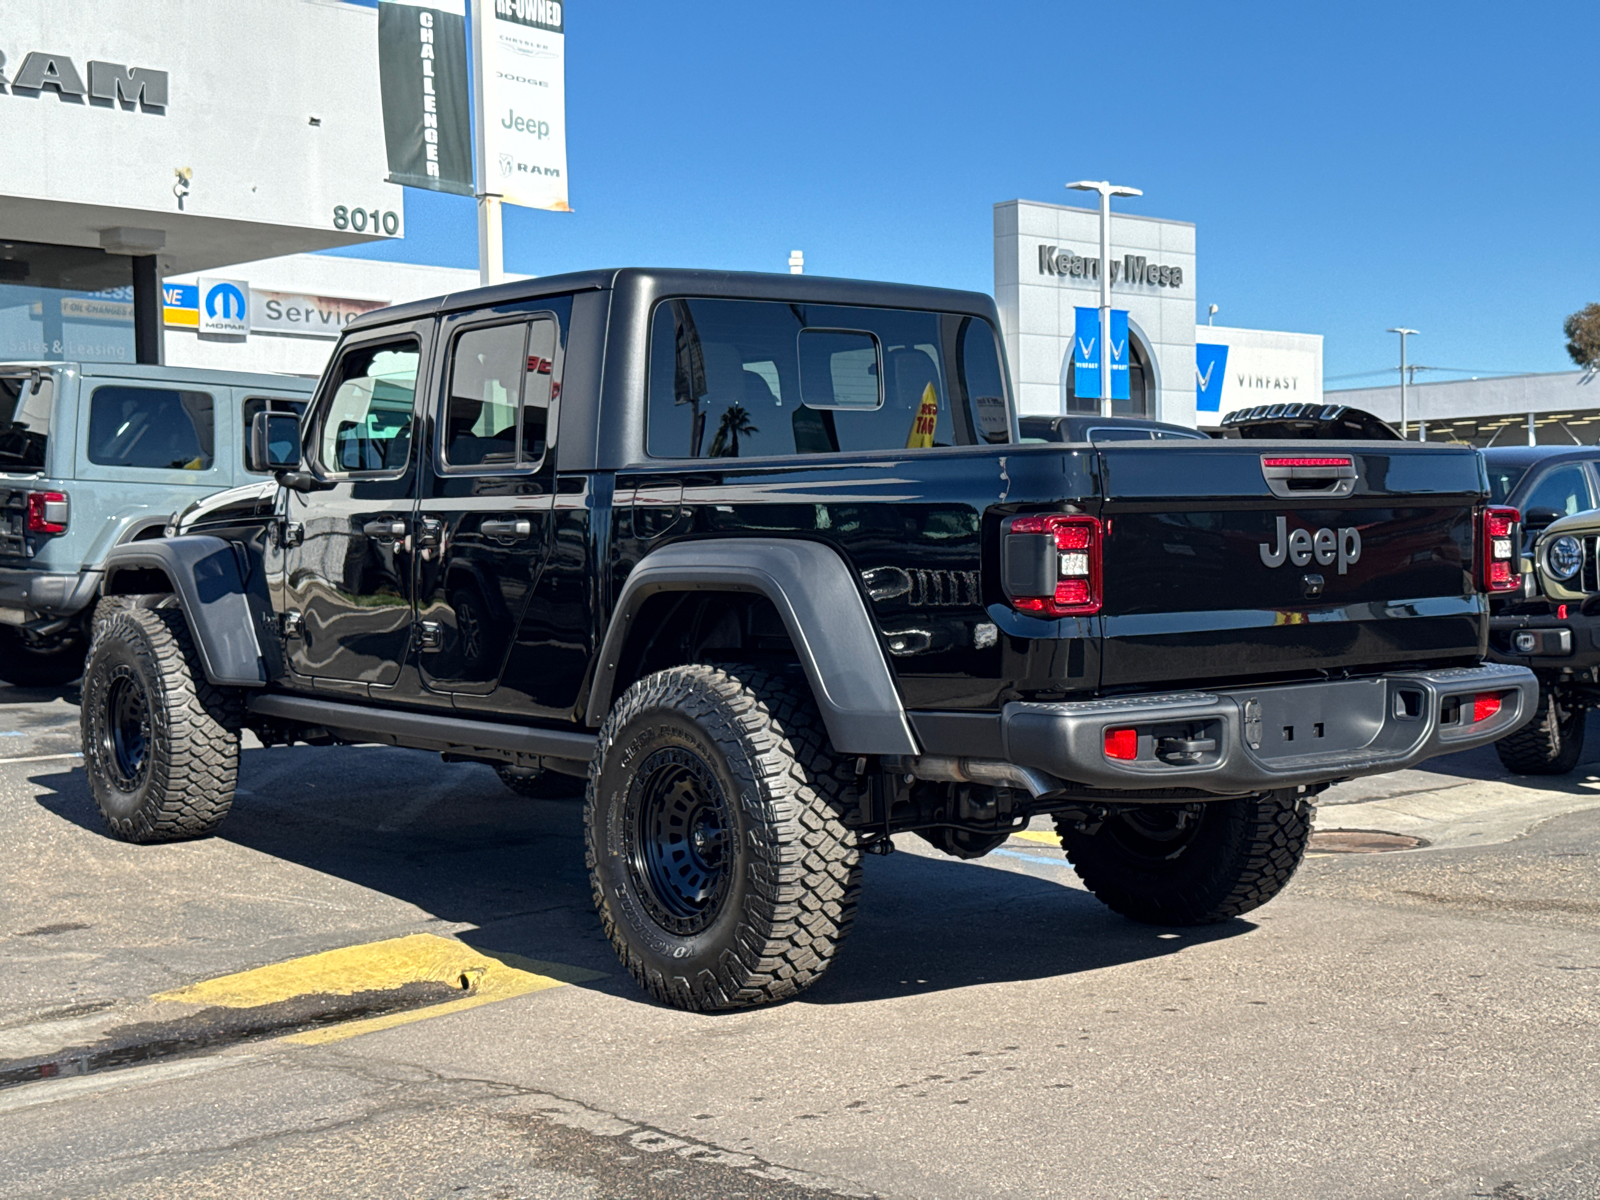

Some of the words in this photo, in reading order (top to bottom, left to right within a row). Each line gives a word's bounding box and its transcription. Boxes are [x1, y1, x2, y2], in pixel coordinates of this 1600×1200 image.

[499, 35, 549, 50] CHRYSLER
[0, 50, 169, 110] AM
[419, 12, 439, 177] CHALLENGER
[501, 109, 549, 140] Jeep
[517, 163, 560, 177] RAM
[333, 205, 399, 235] 8010
[1124, 254, 1183, 287] Mesa
[205, 323, 245, 331] MOPAR
[265, 300, 358, 328] Servic
[9, 339, 48, 353] Sales
[52, 340, 64, 354] &
[69, 340, 125, 360] Leasing
[1237, 373, 1299, 390] VINFAST
[921, 403, 937, 415] RED
[916, 416, 934, 435] TAG
[1259, 516, 1361, 575] Jeep
[614, 882, 696, 959] YOKOHAMA
